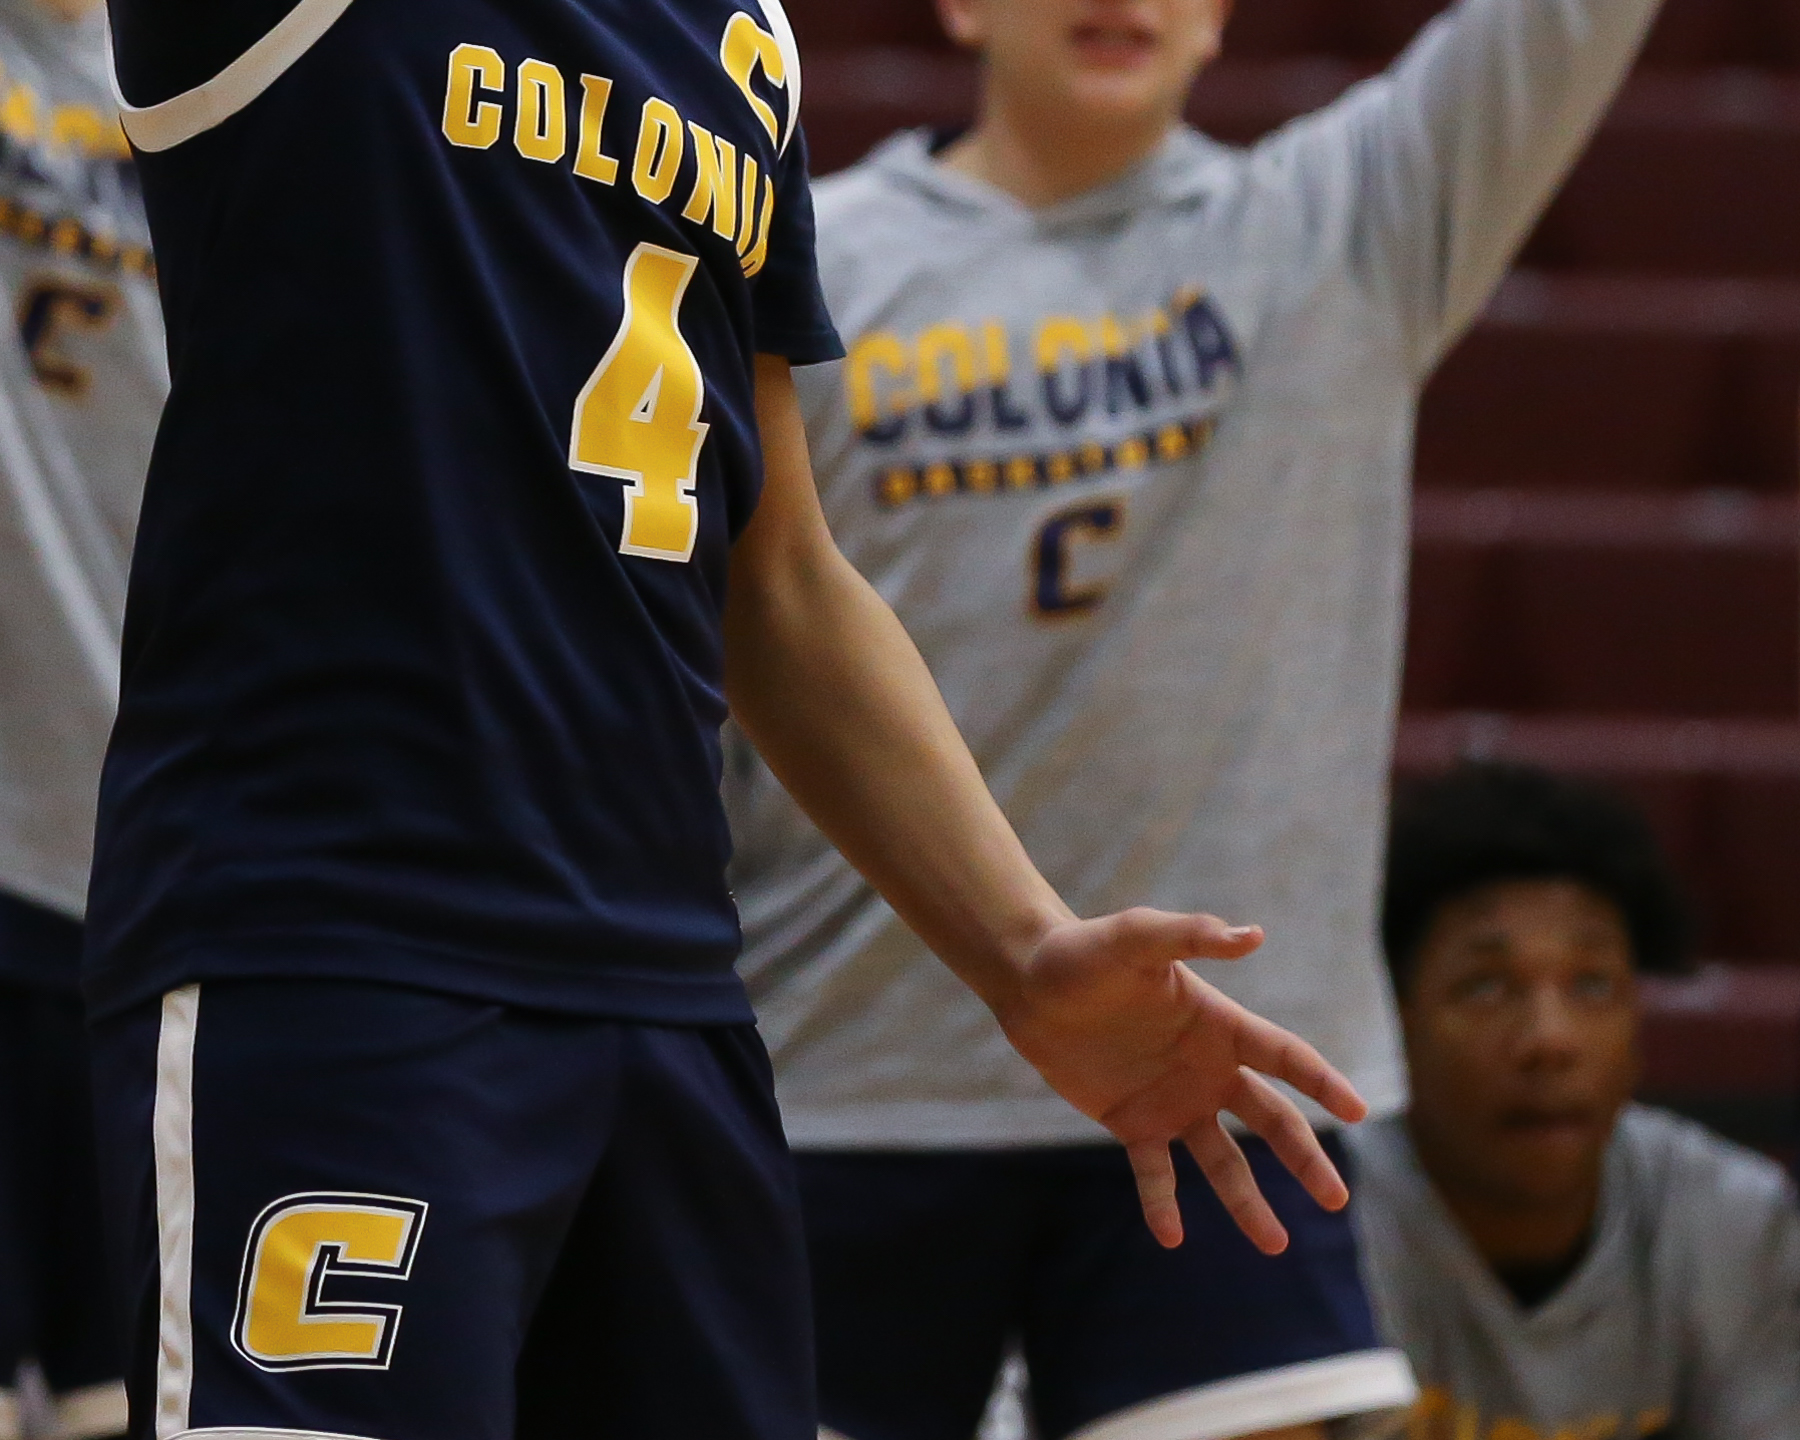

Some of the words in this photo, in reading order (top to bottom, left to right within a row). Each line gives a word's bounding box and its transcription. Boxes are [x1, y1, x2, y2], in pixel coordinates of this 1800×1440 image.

[720, 11, 788, 150] C
[17, 267, 125, 398] C
[569, 242, 710, 563] 4
[842, 280, 1242, 446] COLONIA
[1025, 495, 1128, 622] C
[231, 1191, 429, 1372] C
